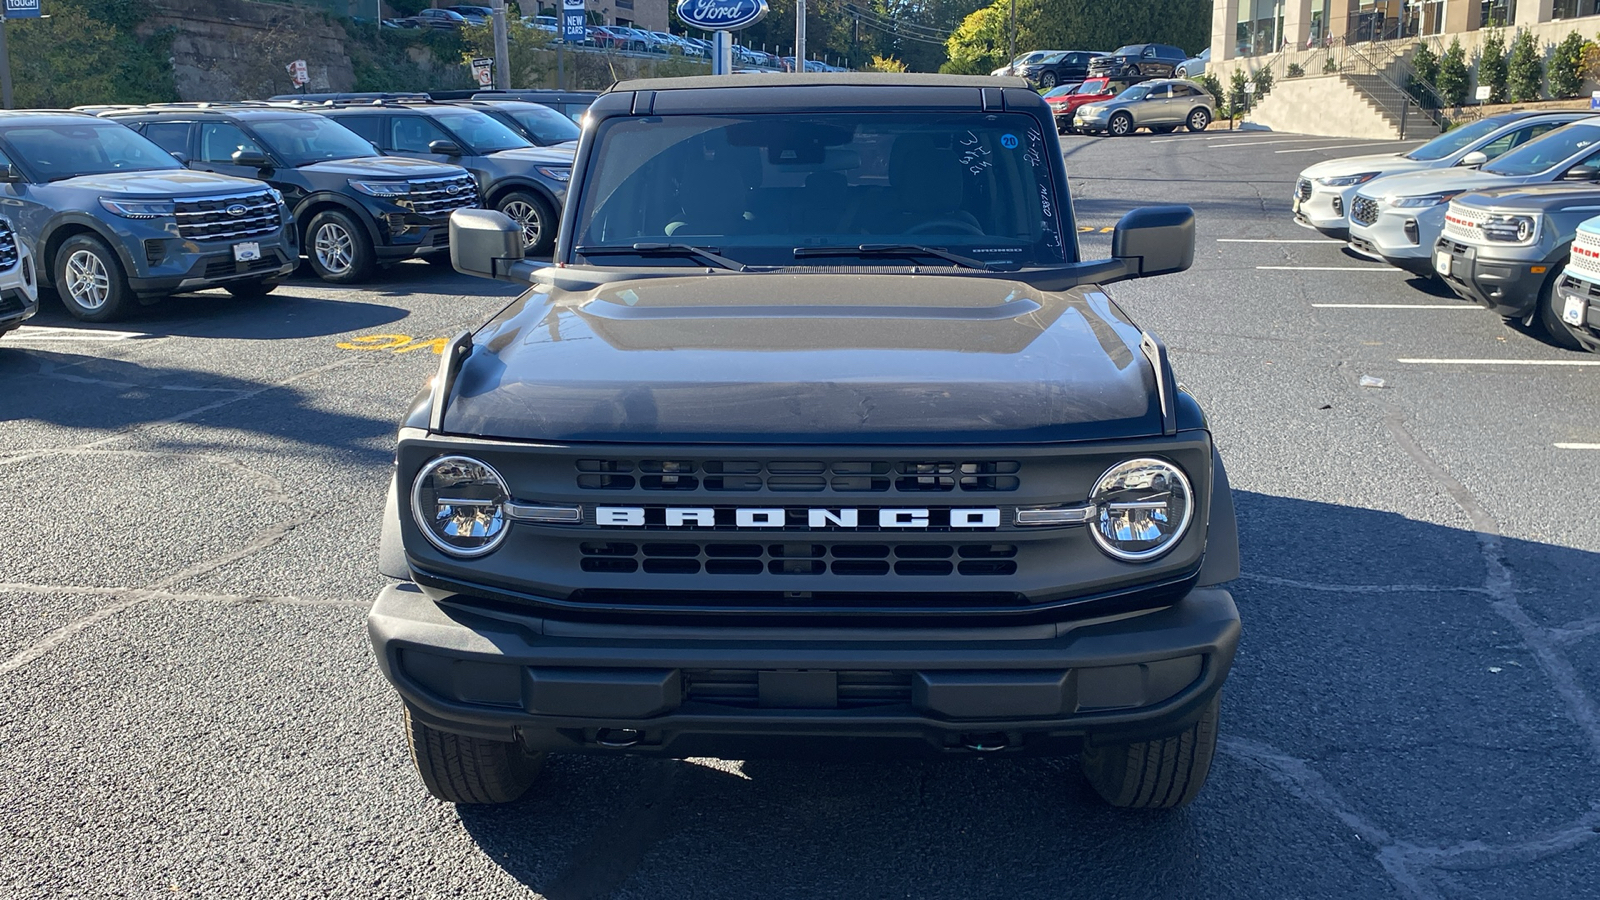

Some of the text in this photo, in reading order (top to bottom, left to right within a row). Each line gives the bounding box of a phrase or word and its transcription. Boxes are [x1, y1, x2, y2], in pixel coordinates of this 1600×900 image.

[693, 0, 743, 20] Ford
[567, 15, 583, 26] NEW
[567, 26, 583, 35] CARS
[1003, 137, 1017, 147] 20
[596, 506, 1000, 527] BRONCO
